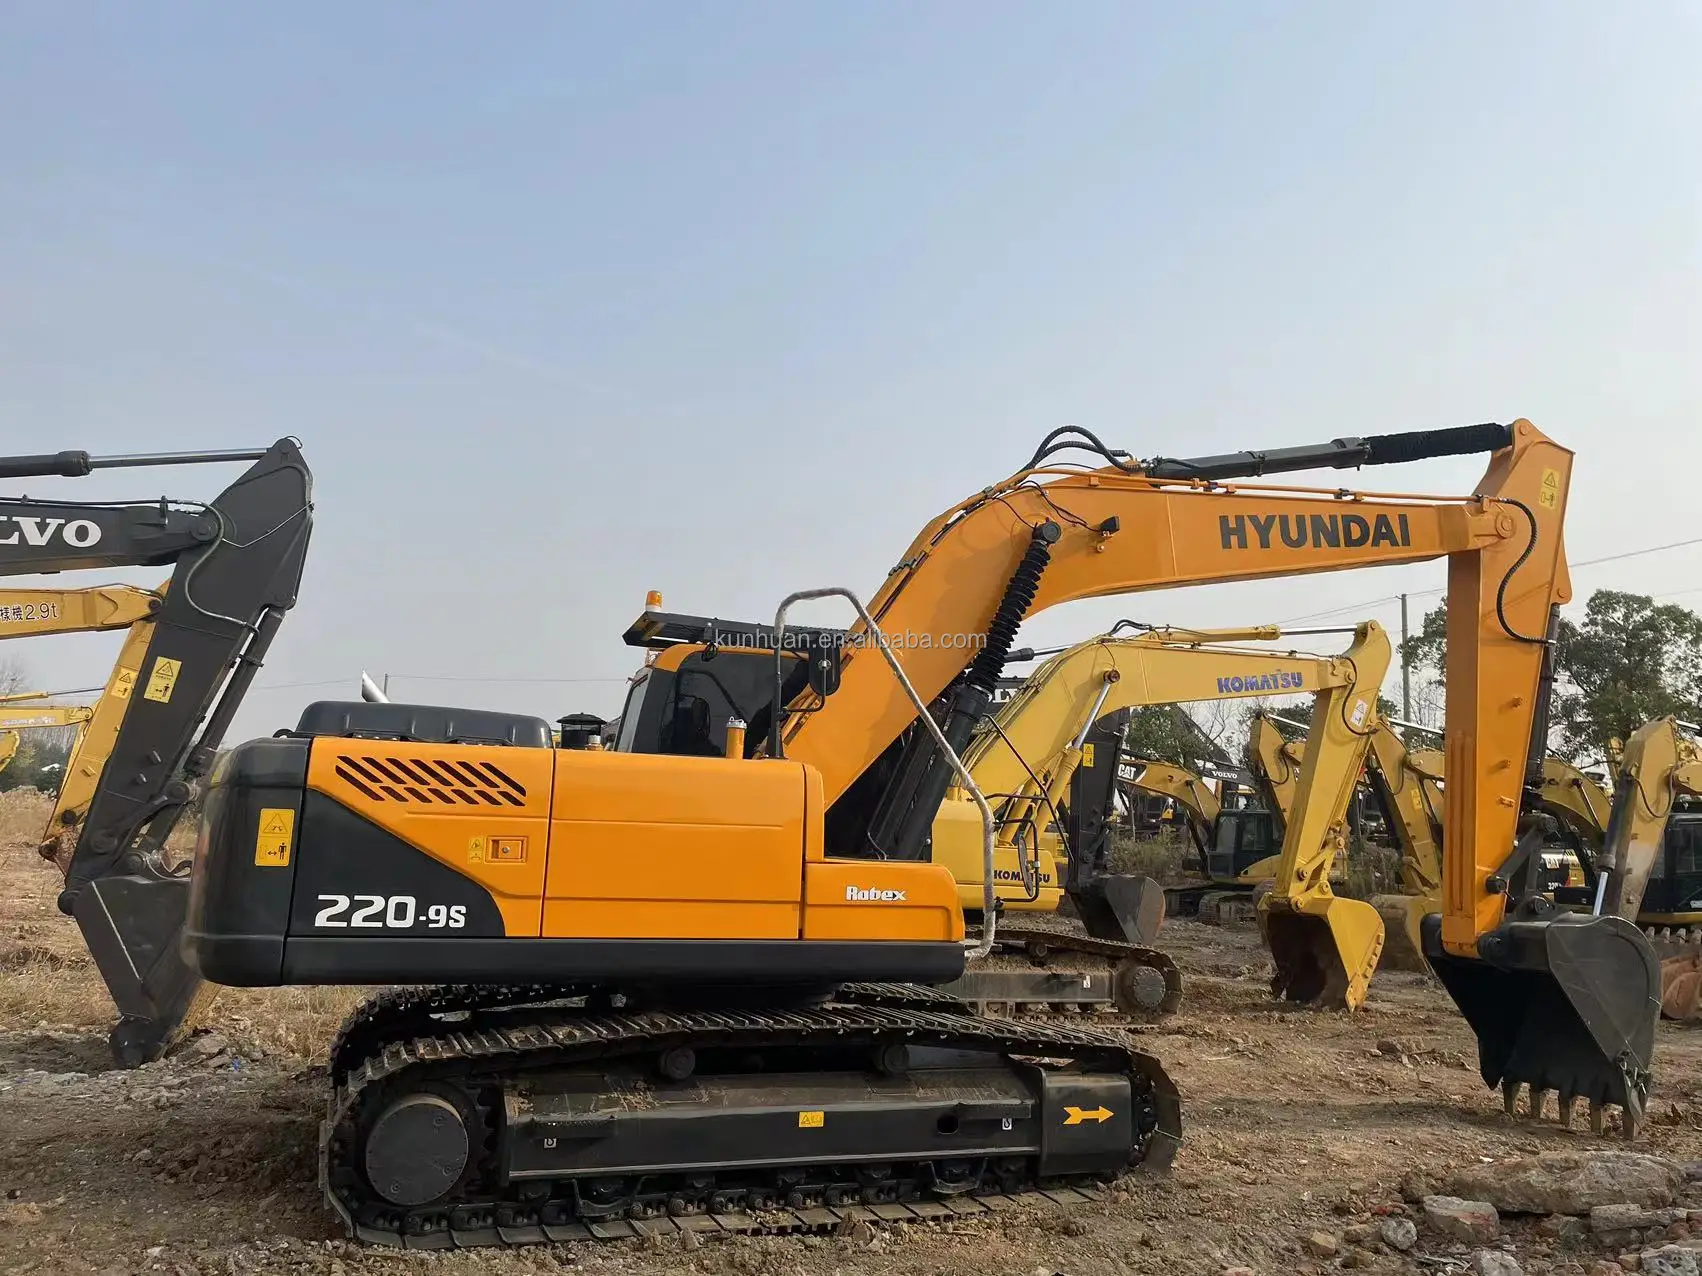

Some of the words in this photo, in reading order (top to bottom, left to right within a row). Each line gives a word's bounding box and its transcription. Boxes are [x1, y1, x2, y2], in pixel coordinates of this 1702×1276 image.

[1219, 514, 1411, 549] HYUNDAI
[1217, 672, 1303, 693] KOMATSU
[1118, 763, 1136, 780] CAT
[1212, 770, 1238, 779] VOLVO
[846, 885, 907, 901] Robex
